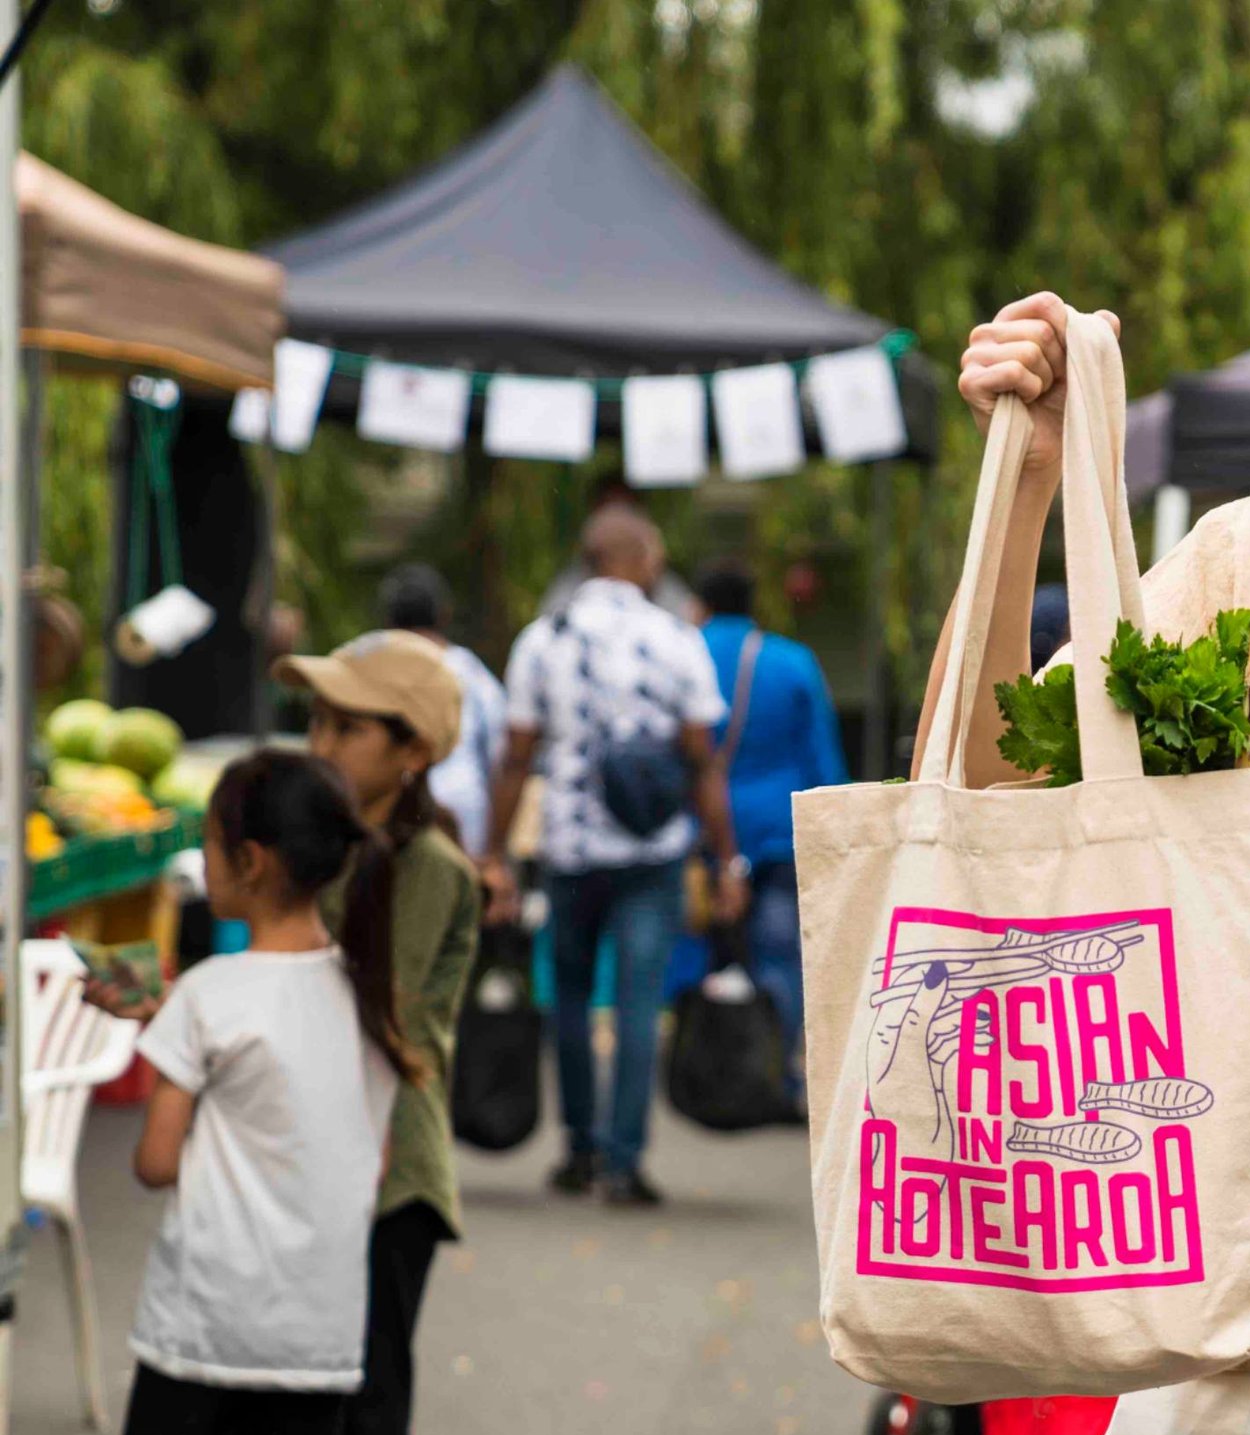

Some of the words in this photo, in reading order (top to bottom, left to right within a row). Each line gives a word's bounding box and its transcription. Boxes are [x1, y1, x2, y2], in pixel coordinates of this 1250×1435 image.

[957, 973, 1186, 1121] ASIAN
[857, 1118, 1203, 1271] AOTEAROA
[958, 1117, 1003, 1165] IN
